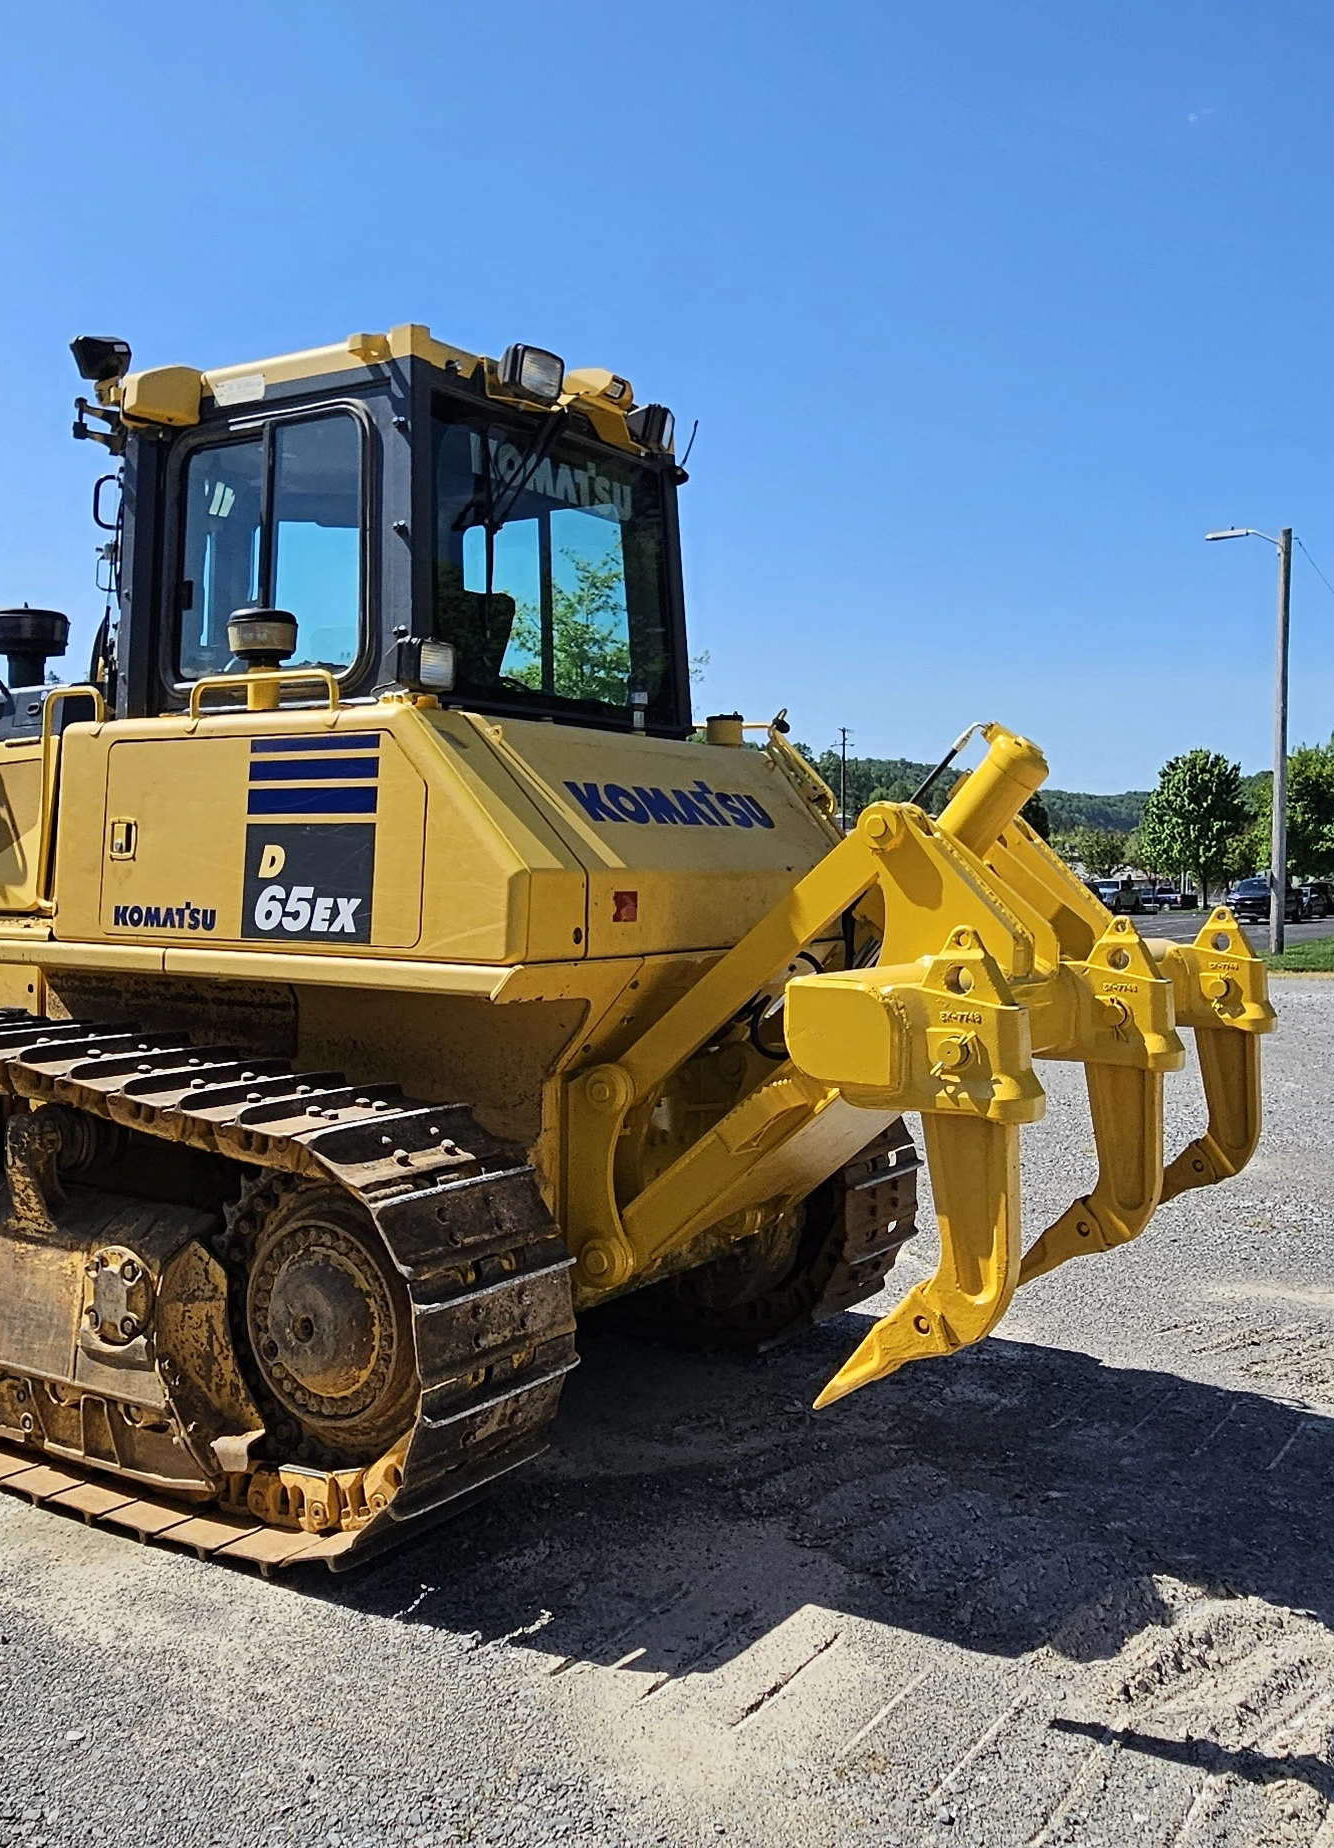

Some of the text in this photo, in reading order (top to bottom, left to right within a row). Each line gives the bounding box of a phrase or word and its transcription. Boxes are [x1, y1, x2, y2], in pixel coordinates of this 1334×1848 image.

[470, 432, 632, 521] KOMATSU
[563, 780, 775, 829] KOMATSU
[258, 845, 285, 878] D
[114, 902, 216, 931] KOMATSU
[254, 885, 362, 932] 65EX
